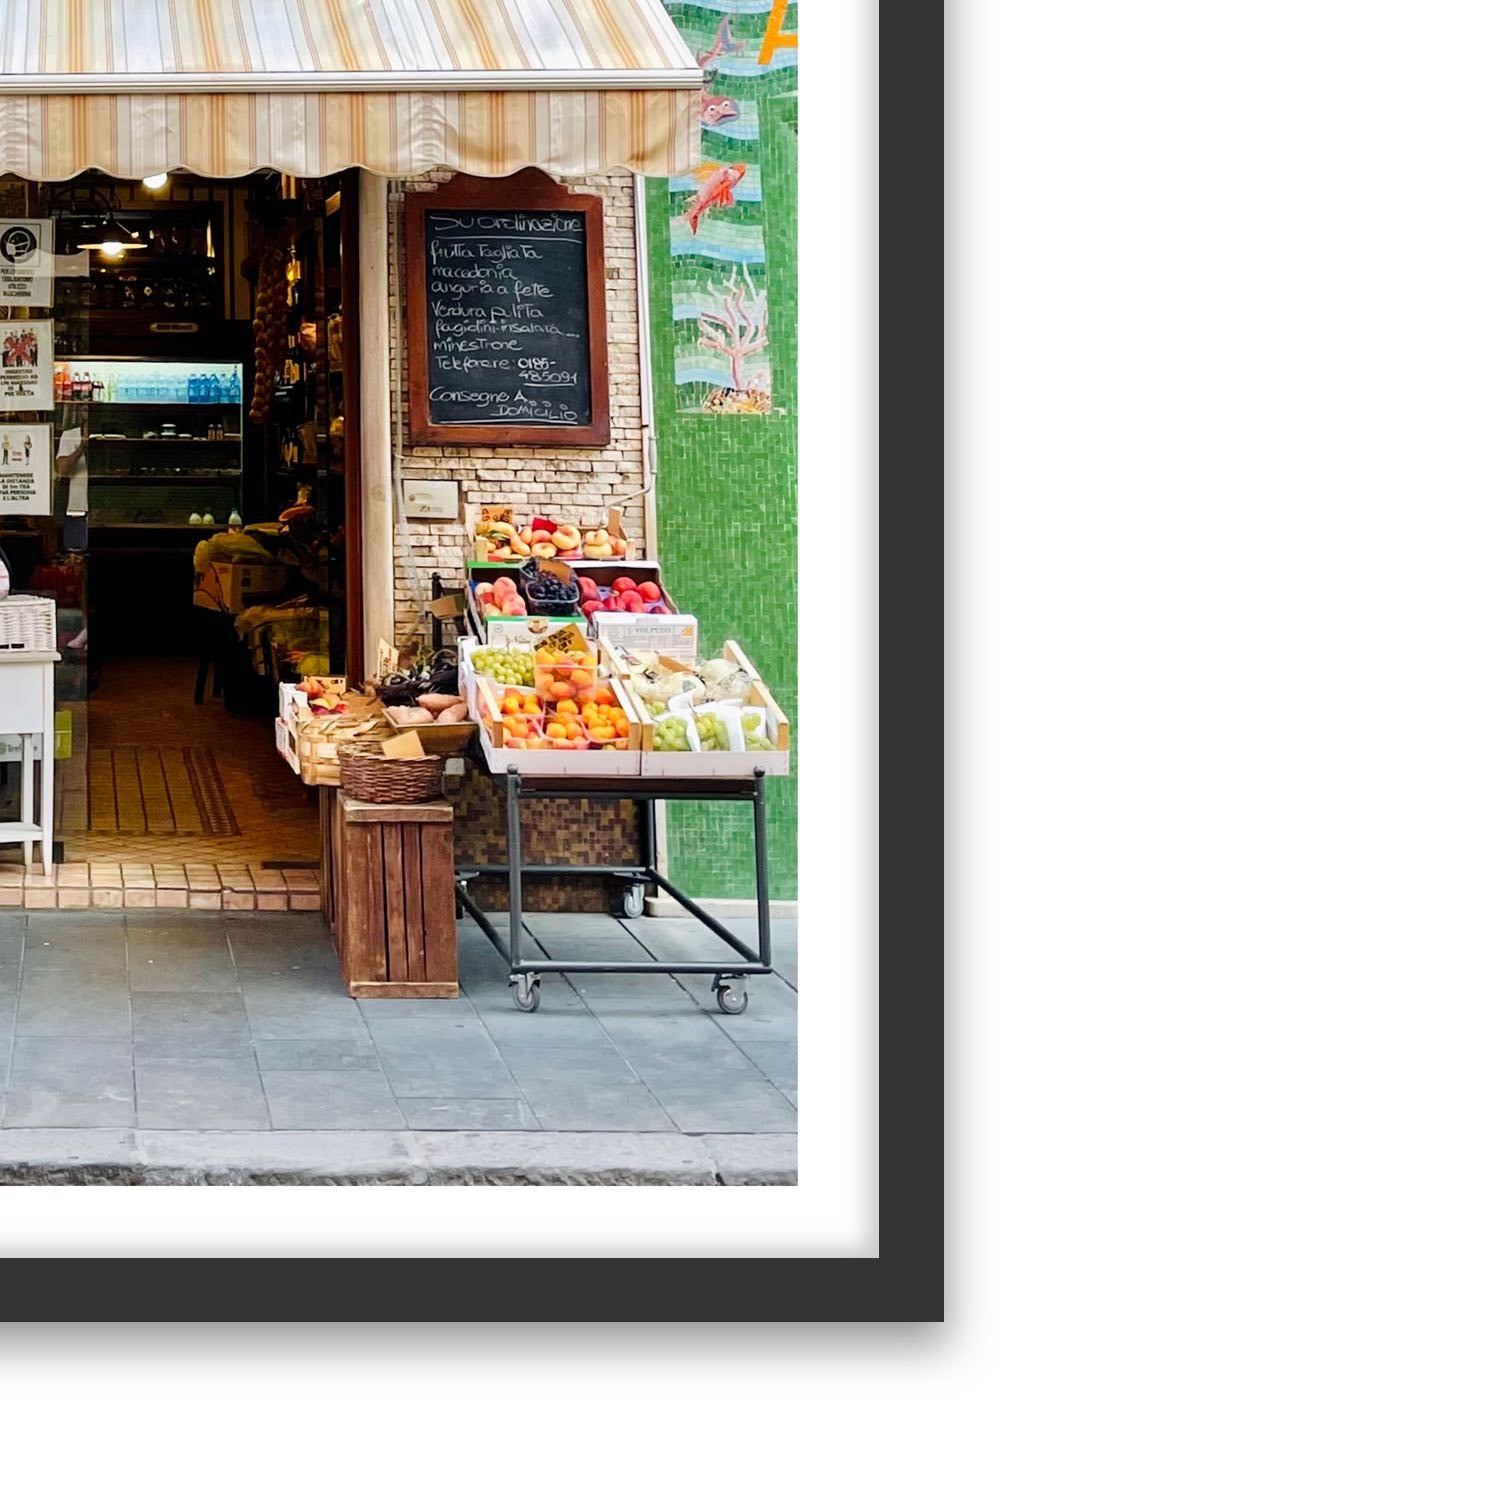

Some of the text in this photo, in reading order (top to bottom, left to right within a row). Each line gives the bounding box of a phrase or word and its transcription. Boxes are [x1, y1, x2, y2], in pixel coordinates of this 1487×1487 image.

[432, 263, 518, 280] macedonia
[431, 280, 554, 302] anguria a fette
[431, 300, 487, 317] Verdura
[433, 337, 523, 352] minestrone
[429, 386, 510, 407] Consegne
